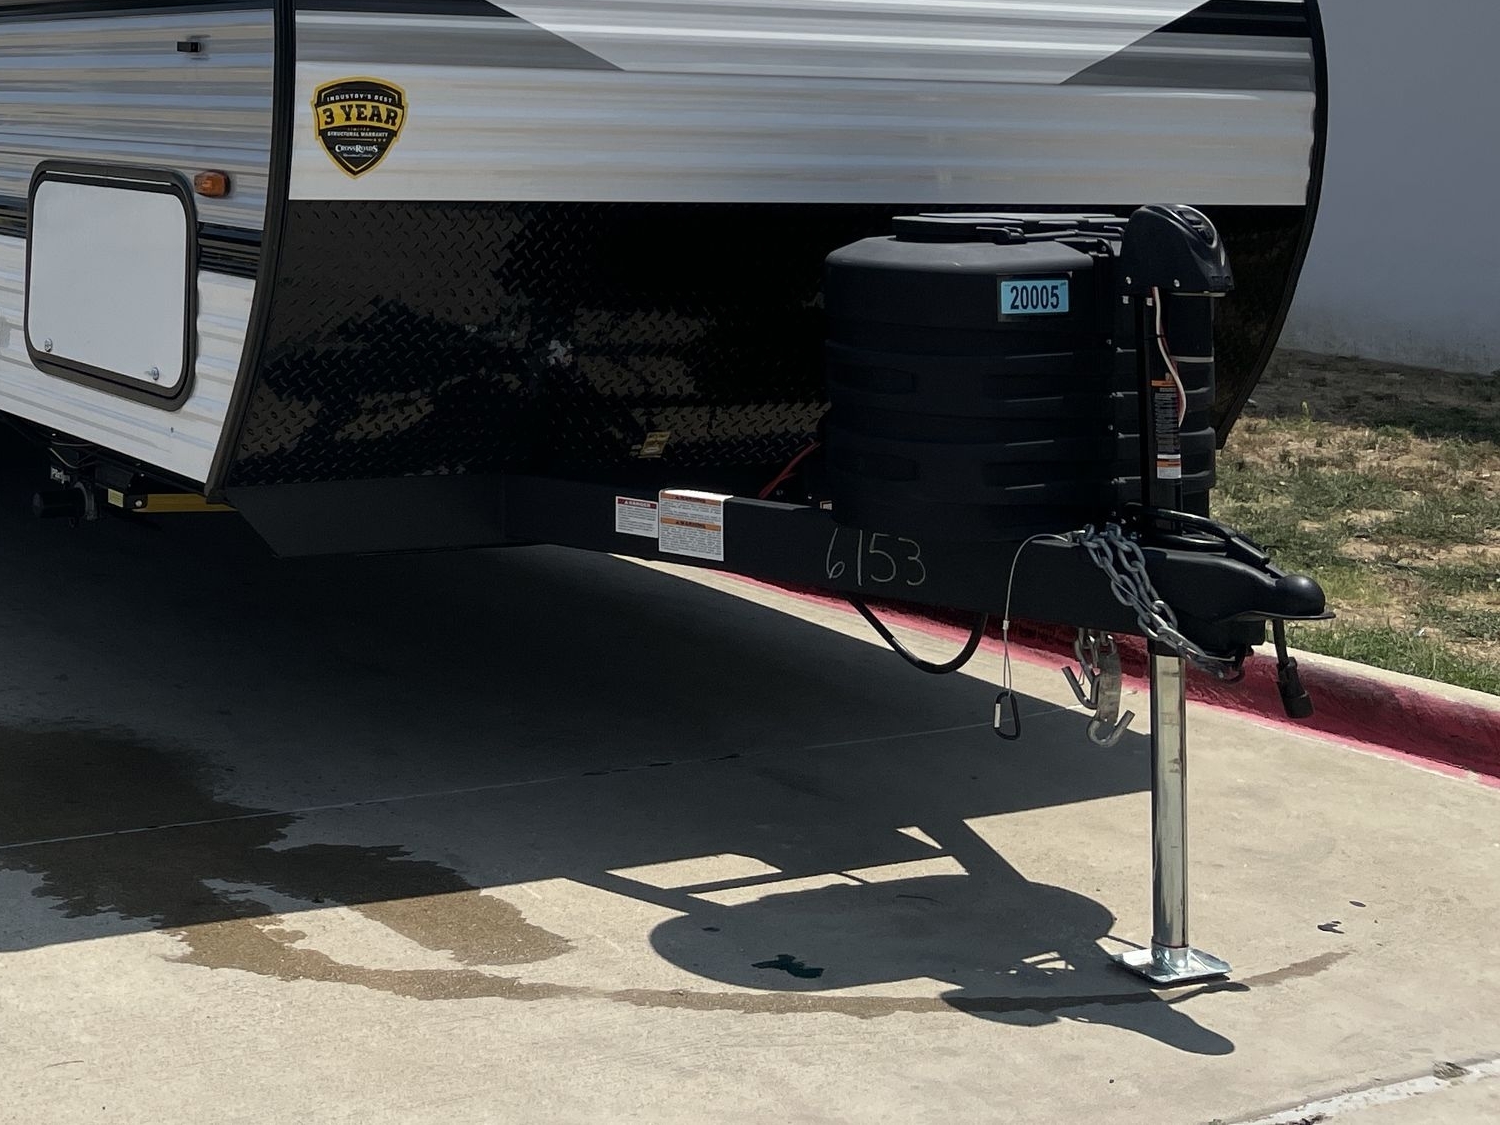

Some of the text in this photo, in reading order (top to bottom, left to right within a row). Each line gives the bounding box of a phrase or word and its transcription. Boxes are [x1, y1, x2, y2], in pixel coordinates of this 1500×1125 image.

[322, 104, 398, 126] 3 YEAR
[1010, 285, 1060, 310] 20005
[826, 527, 926, 586] 6153
